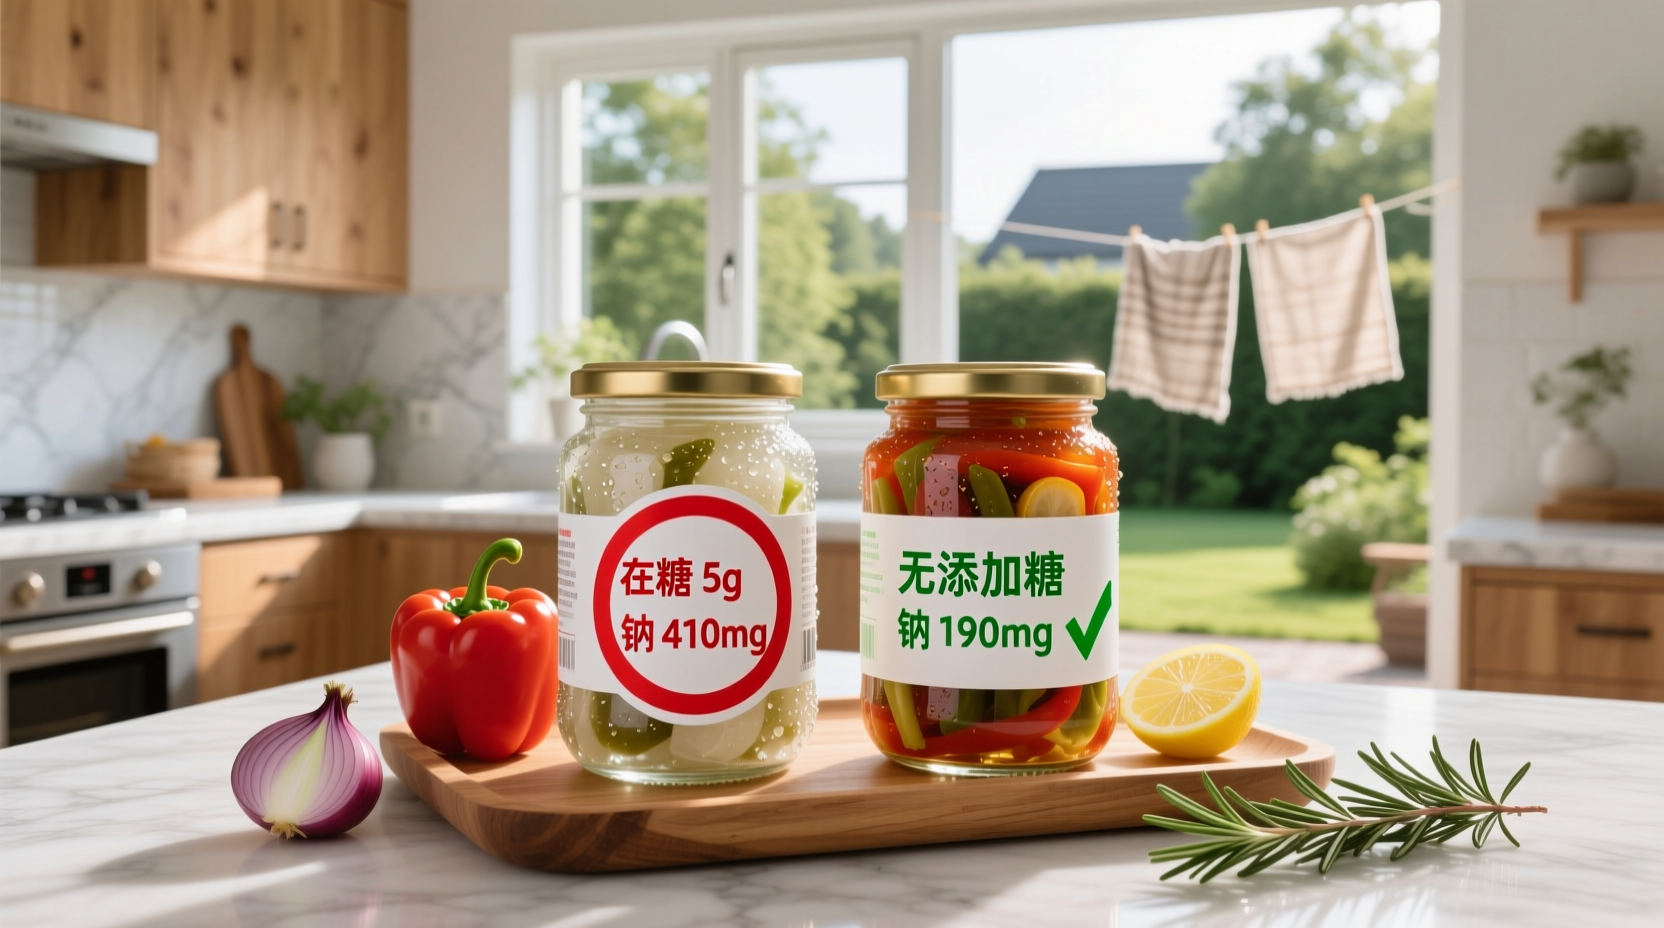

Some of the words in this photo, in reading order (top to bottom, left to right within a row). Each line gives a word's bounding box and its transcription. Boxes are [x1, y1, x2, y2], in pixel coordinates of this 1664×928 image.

[620, 557, 693, 597] 在糖
[702, 561, 742, 602] 5g
[898, 550, 1065, 597] 无添加糖
[621, 613, 654, 653] 钠
[661, 617, 767, 656] 410mg
[898, 608, 930, 650] 钠
[939, 615, 1052, 657] 190mg
